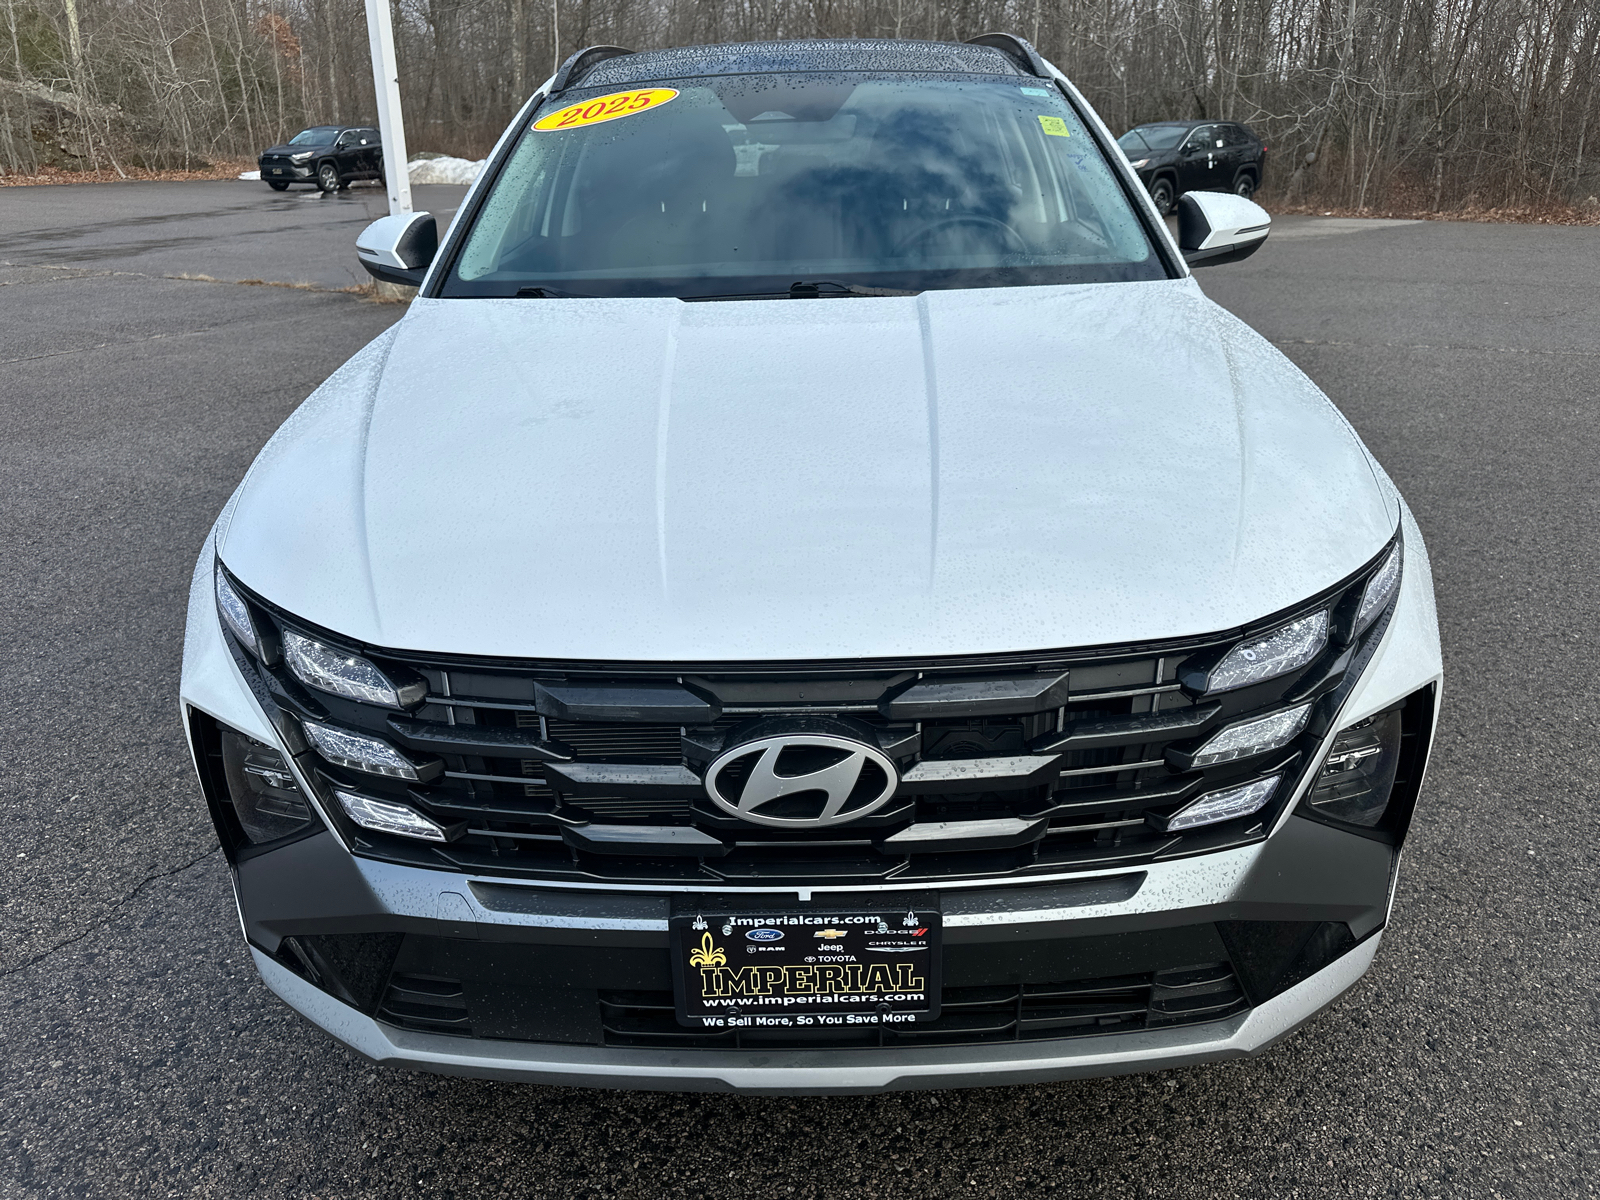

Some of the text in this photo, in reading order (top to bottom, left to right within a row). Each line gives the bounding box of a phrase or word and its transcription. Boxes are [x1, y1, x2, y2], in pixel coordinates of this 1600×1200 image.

[557, 91, 655, 127] 2025
[729, 915, 881, 927] Imperialcars.com
[754, 931, 776, 939] Ford
[818, 943, 843, 952] Jeep
[701, 964, 924, 997] IMPERIAL
[702, 993, 924, 1007] www.imperialcars.com
[702, 1013, 916, 1027] We Sell More, So You Save More
